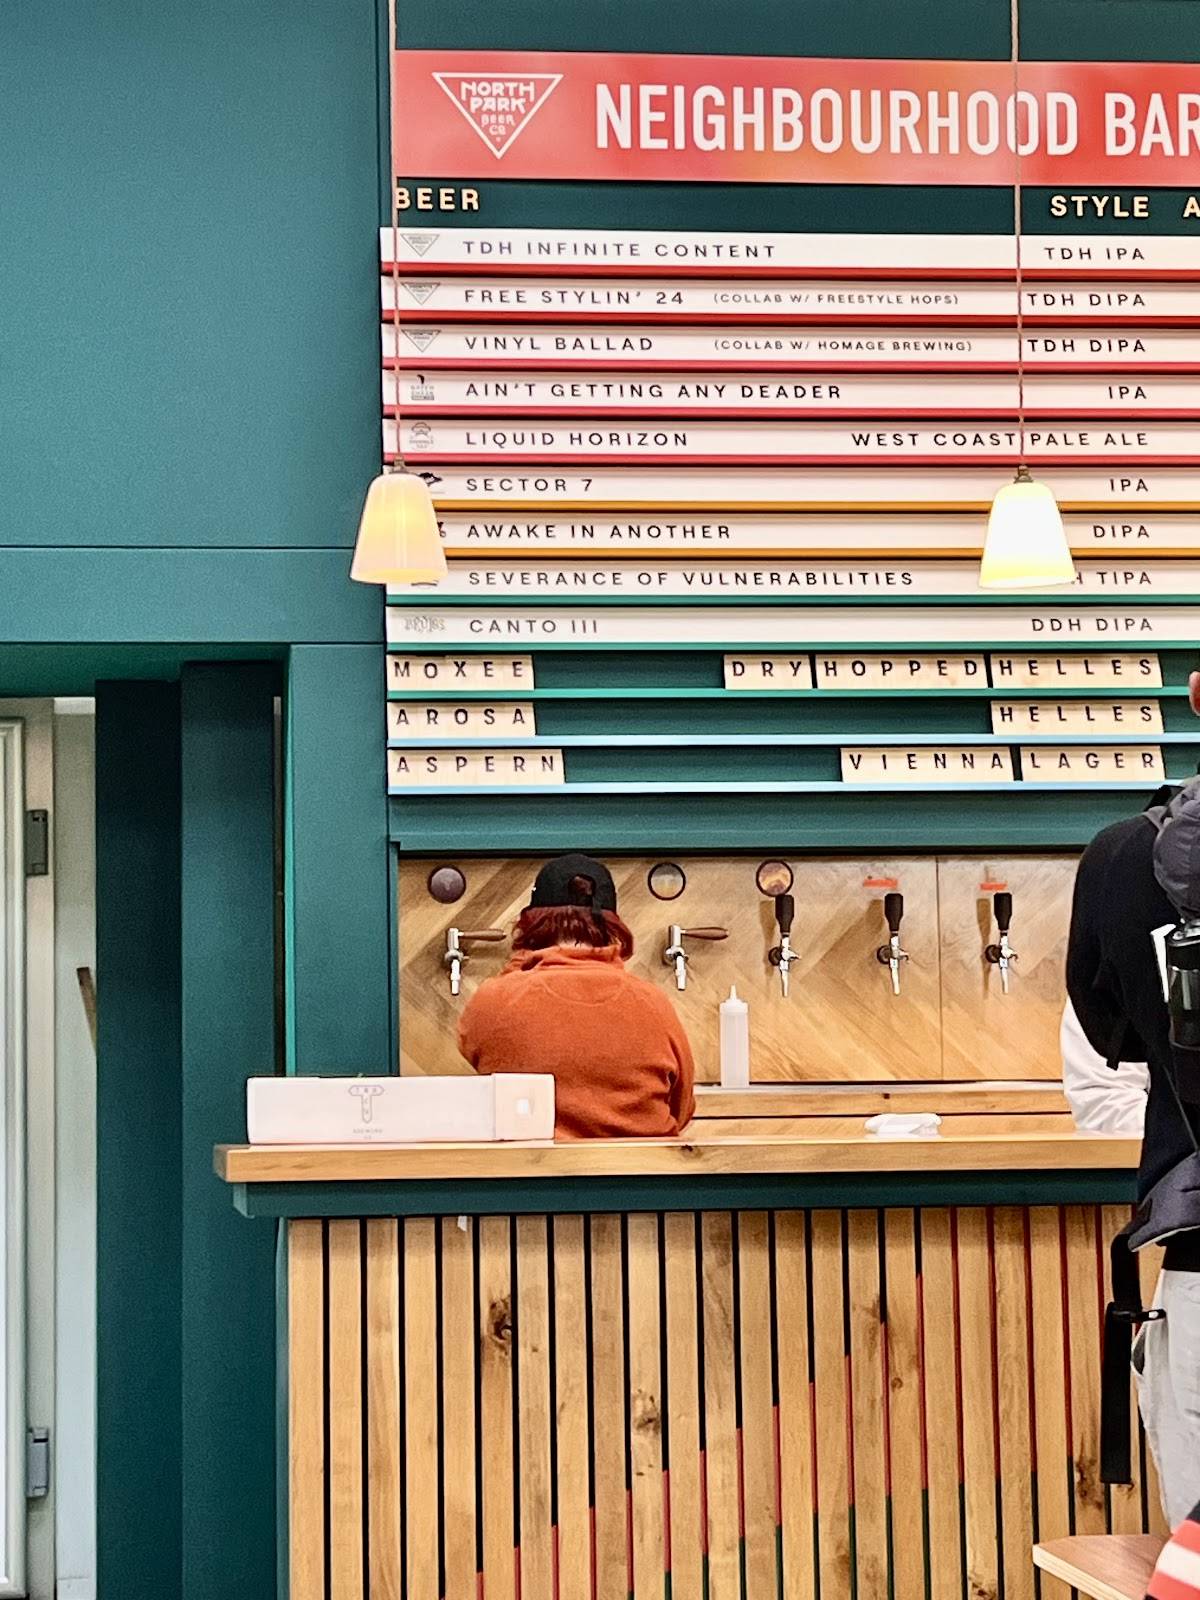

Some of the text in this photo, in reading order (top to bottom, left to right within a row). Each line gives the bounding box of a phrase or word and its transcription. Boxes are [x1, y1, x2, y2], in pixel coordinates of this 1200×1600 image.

[460, 81, 535, 102] NORTH
[470, 96, 526, 114] PARK
[481, 114, 515, 128] BEER
[595, 82, 1079, 157] NEIGHBOURHOOD
[395, 187, 480, 211] BEER
[1050, 195, 1150, 218] STYLE
[462, 241, 774, 258] TDH INFINITE CONTENT
[1044, 247, 1145, 260] TDH IPA
[464, 290, 529, 305] FREE
[655, 291, 685, 305] 24
[713, 293, 960, 306] (COLLAB W/ FREESTYLE HOPS)
[1026, 293, 1146, 307] TDH DIPA
[464, 336, 653, 351] VINYL BALLAD
[714, 340, 973, 352] (COLLAB W/ HOMAGE BREWING)
[1026, 338, 1147, 353] TDH DIPA
[465, 383, 840, 399] AIN'T GETTING ANY DEADER
[1108, 385, 1147, 400] IPA
[465, 431, 687, 449] LIQUID HORIZON
[851, 432, 1148, 447] WEST COAST PALE ALE
[466, 478, 593, 492] SECTOR 7
[1109, 478, 1149, 492] IPA
[467, 523, 730, 539] AWAKE IN ANOTHER
[1092, 524, 1150, 538] DIPA
[468, 571, 913, 586] SEVERANCE OF VULNERABILITIES
[1095, 571, 1152, 585] TIPA
[469, 619, 597, 634] CANTO III
[1031, 617, 1153, 632] DDH DIPA
[394, 660, 524, 679] MOXEE
[731, 658, 1153, 677] DRY HOPPED HELLES
[396, 706, 525, 725] AROSA
[999, 704, 1152, 723] HELLES
[397, 755, 554, 773] ASPERN
[848, 751, 1154, 770] VIENNA LAGER
